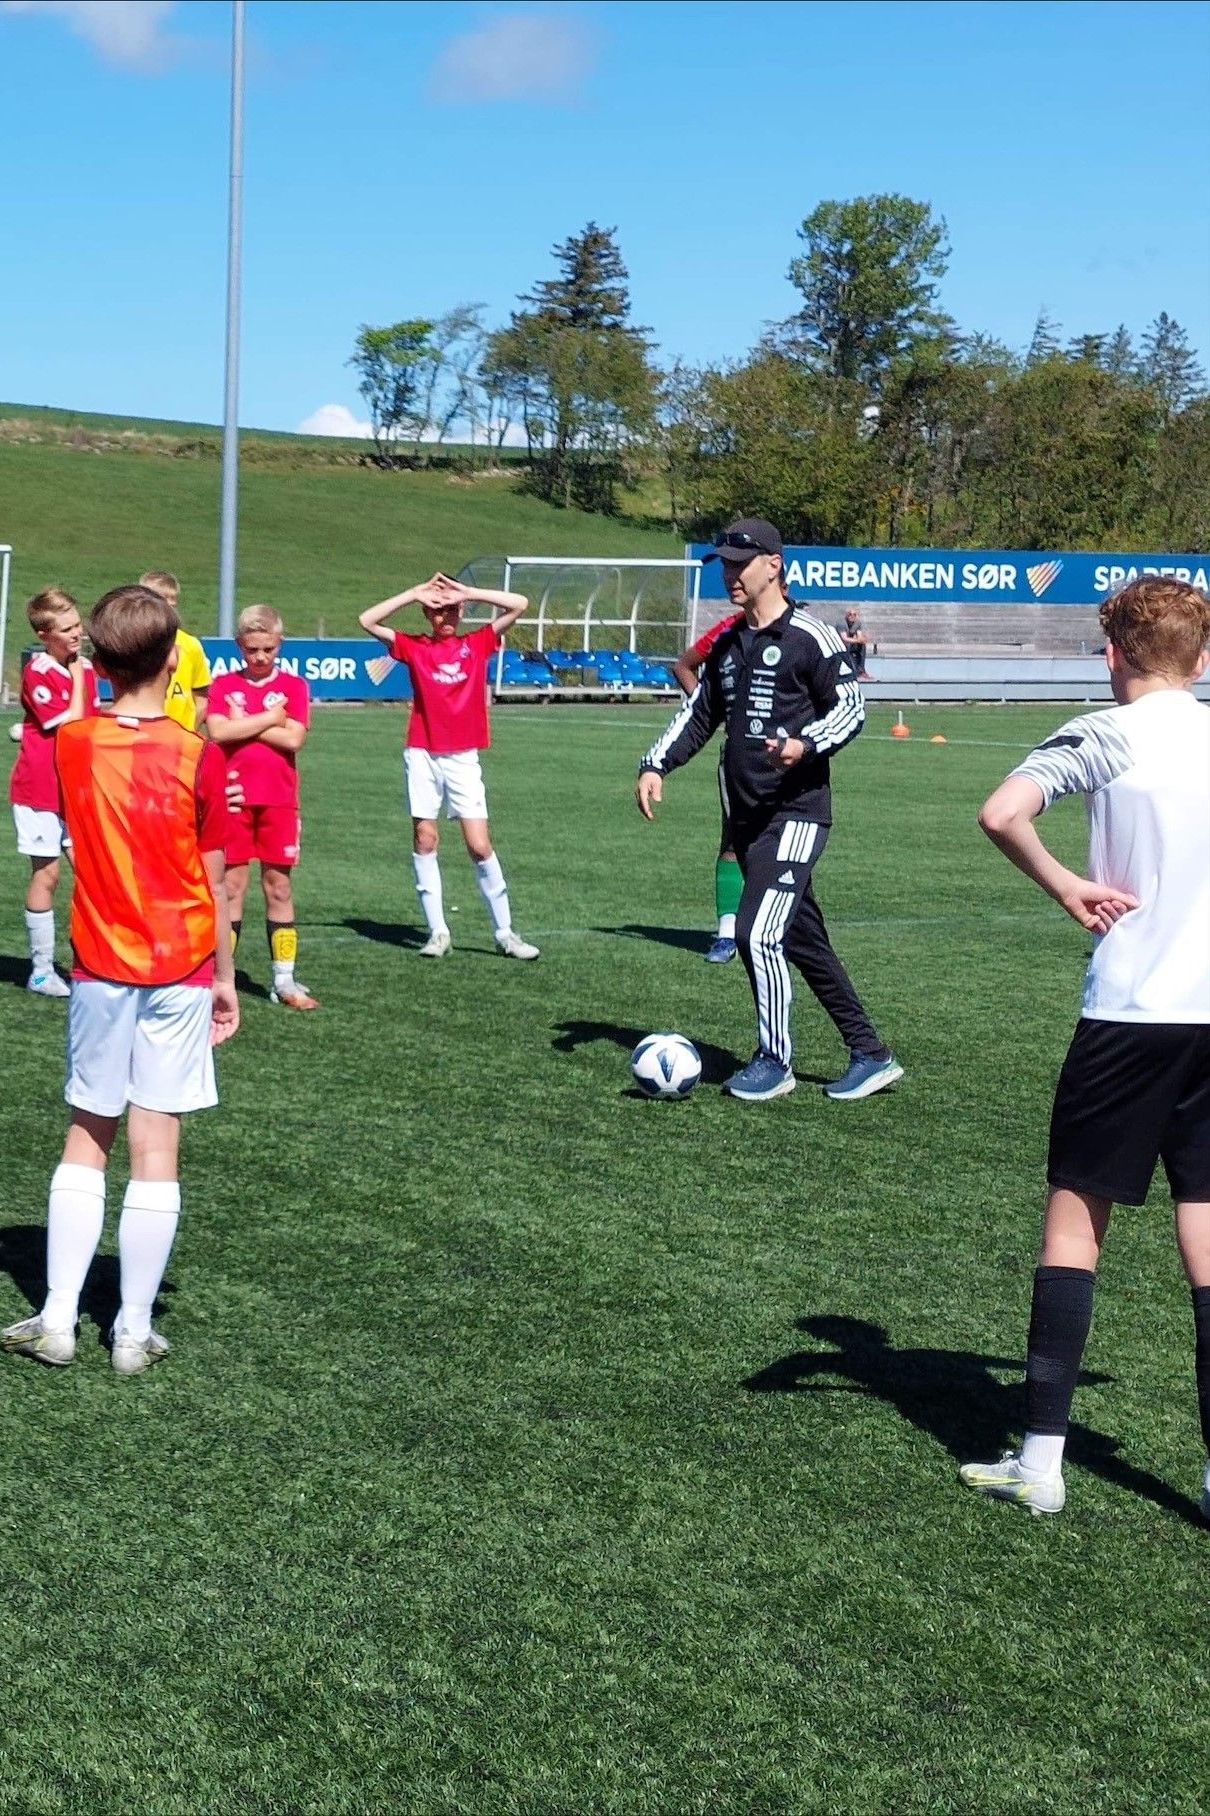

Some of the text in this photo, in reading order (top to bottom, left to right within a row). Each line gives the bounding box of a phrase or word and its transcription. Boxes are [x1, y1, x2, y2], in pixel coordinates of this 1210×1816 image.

[783, 559, 1016, 590] AREBANKEN SØR
[305, 657, 357, 681] SØR
